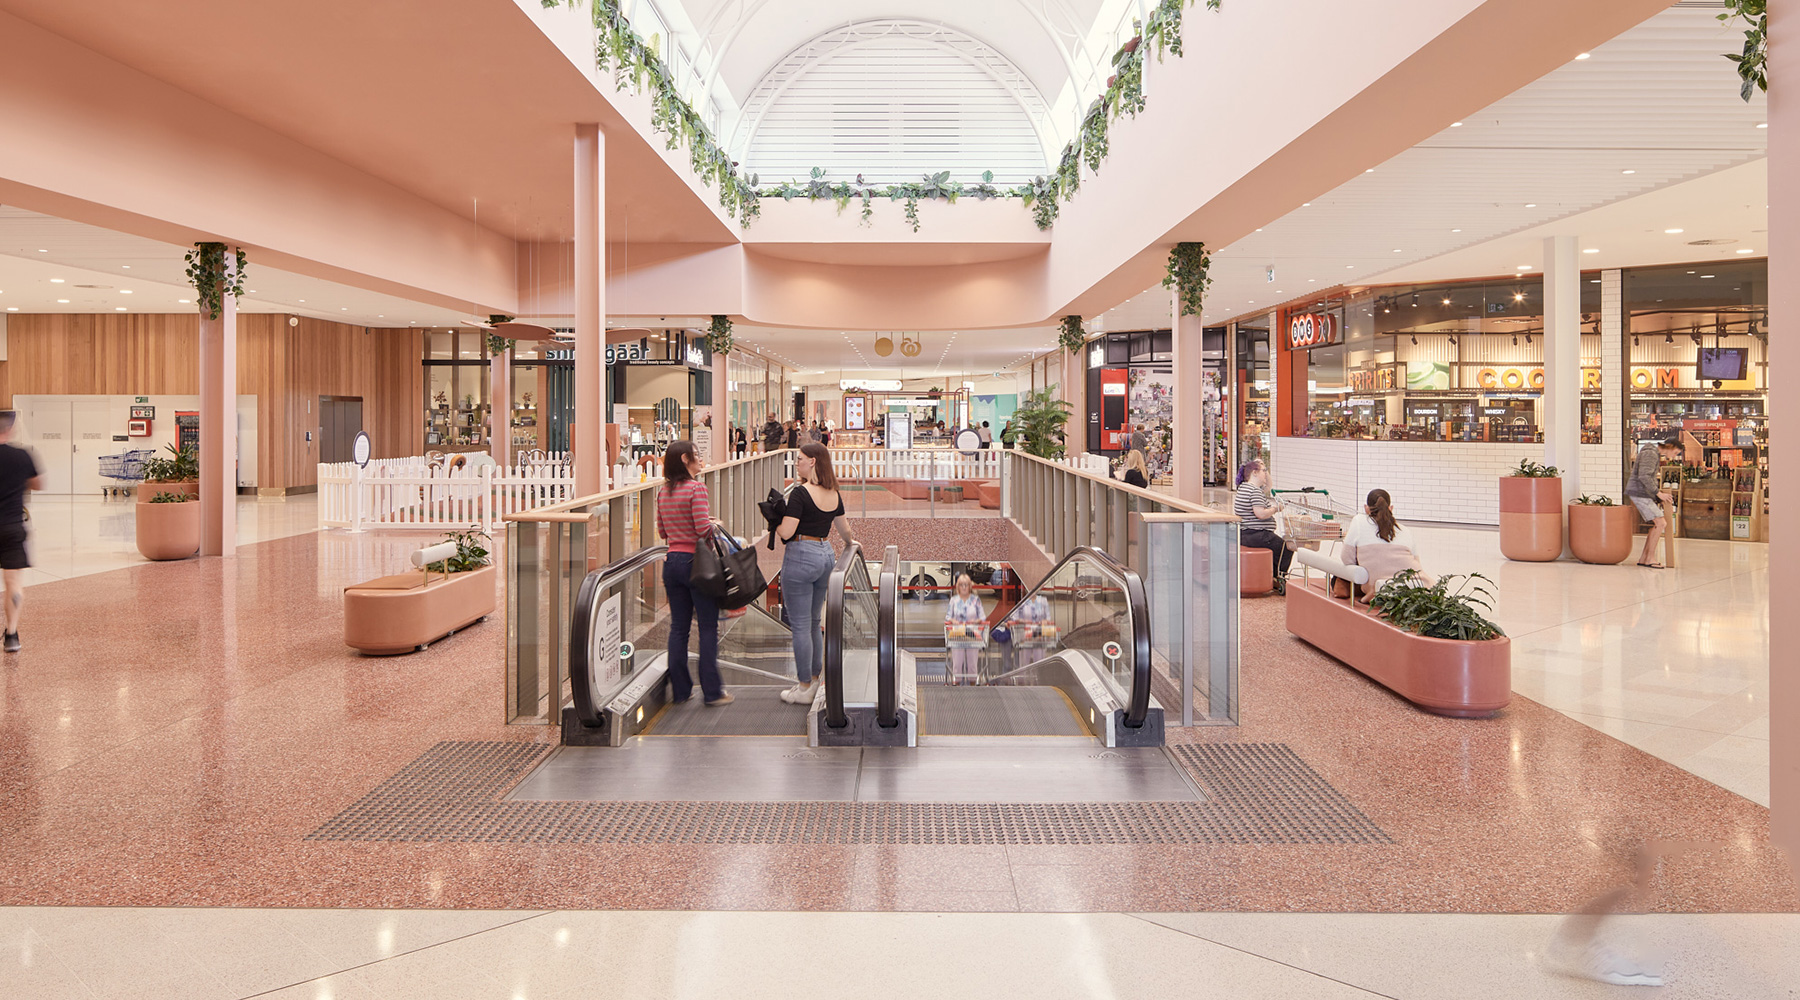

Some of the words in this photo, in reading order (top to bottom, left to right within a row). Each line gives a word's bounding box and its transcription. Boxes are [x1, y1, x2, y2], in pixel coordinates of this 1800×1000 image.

[1349, 368, 1392, 390] SPIRITS
[1477, 368, 1544, 388] COO
[1582, 368, 1679, 388] ROM
